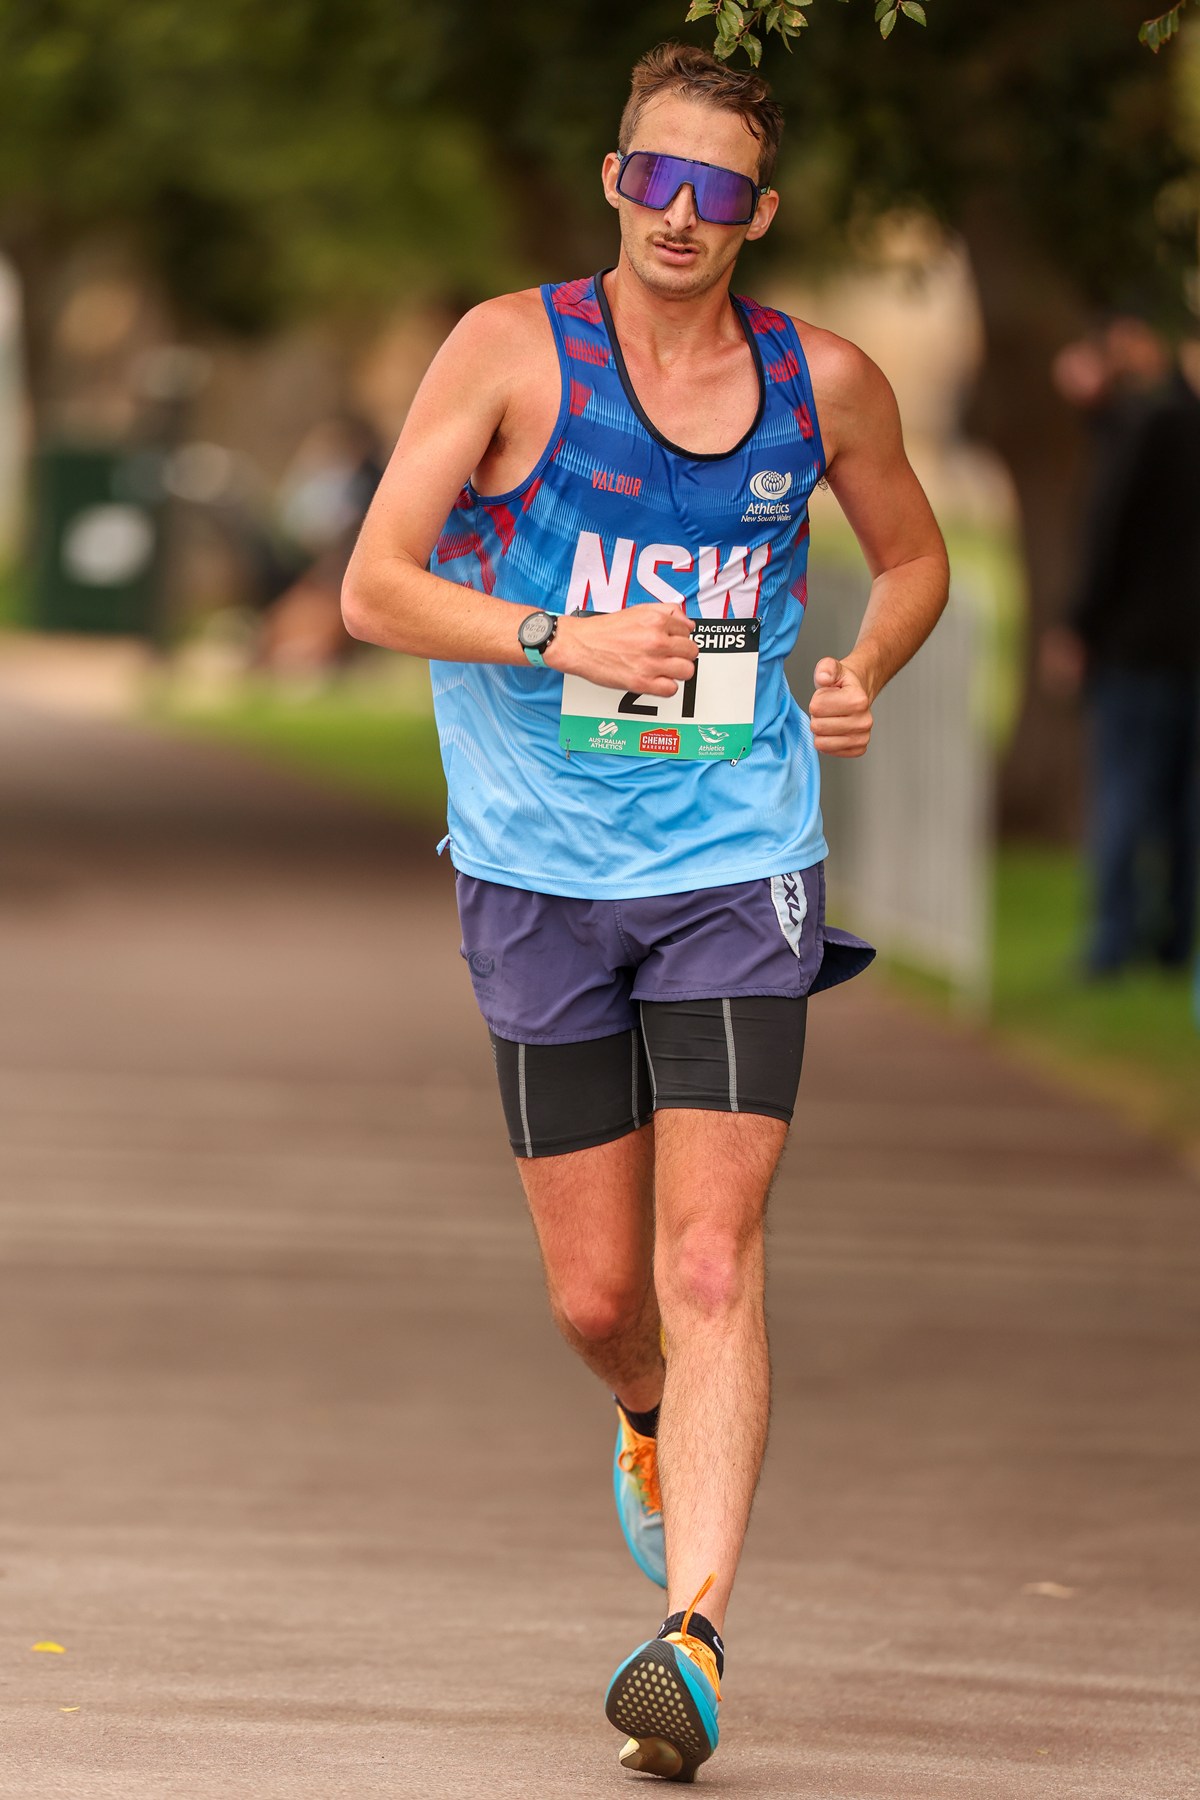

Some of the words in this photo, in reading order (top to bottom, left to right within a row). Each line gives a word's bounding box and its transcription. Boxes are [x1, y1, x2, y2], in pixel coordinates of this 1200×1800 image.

[591, 470, 642, 497] VALOUR
[745, 502, 790, 515] Athletics
[741, 515, 756, 523] New
[757, 515, 777, 523] South
[776, 514, 792, 522] Wales
[565, 531, 771, 618] NSW
[698, 625, 747, 633] RACEWALK
[588, 737, 626, 745] AUSTRALIAN
[642, 736, 678, 746] CHEMIST
[590, 743, 623, 751] ATHLETICS
